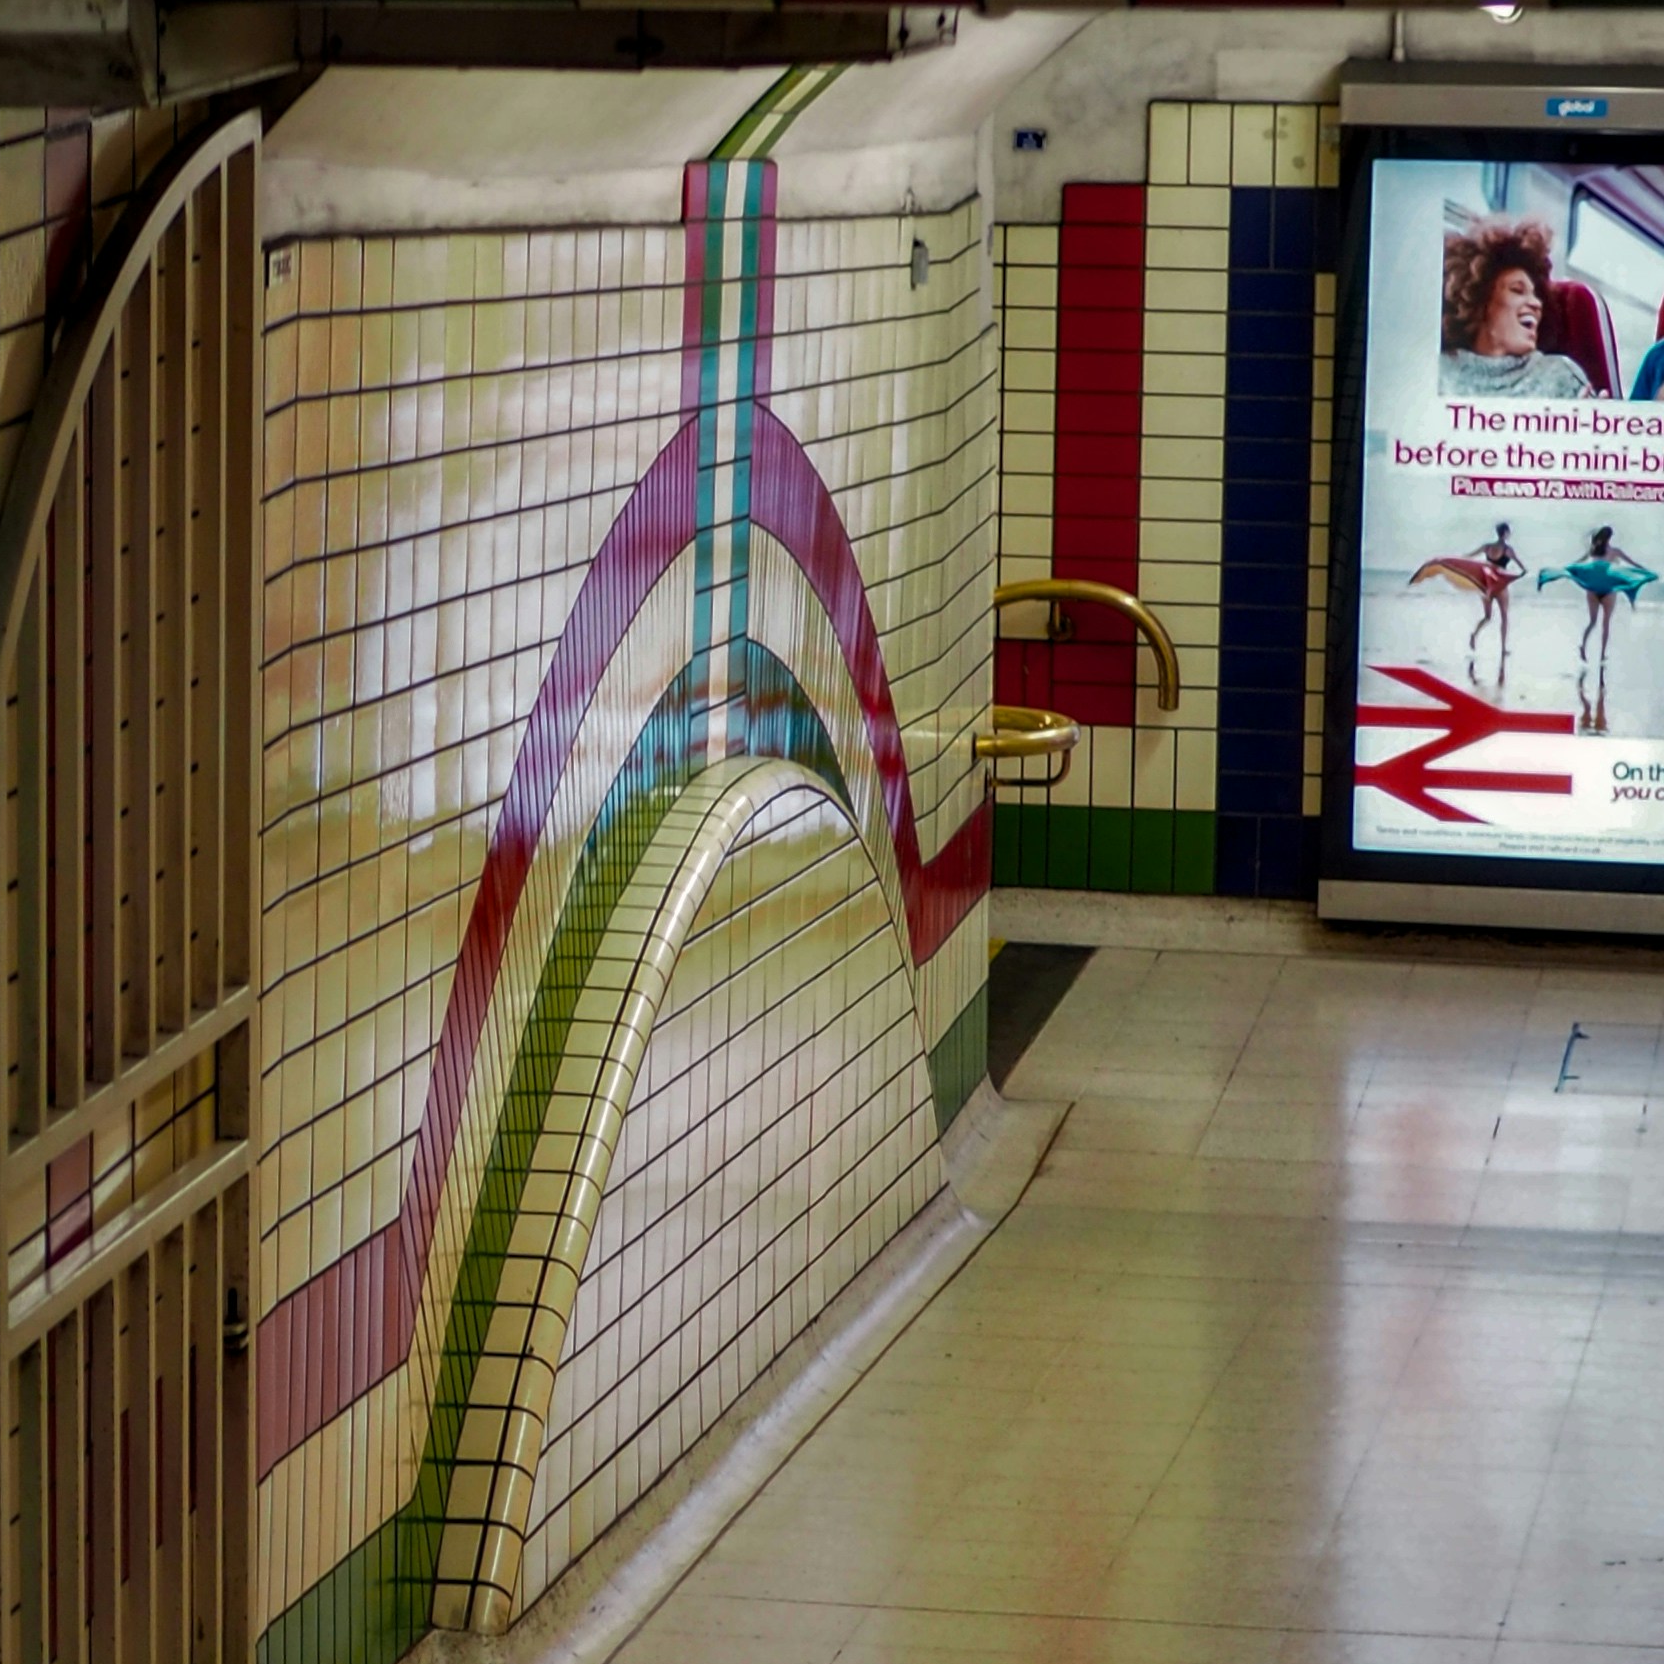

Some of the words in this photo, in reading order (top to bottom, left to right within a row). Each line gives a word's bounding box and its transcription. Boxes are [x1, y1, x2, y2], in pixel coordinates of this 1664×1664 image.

[1446, 404, 1506, 431] The
[1394, 439, 1498, 467] before
[1505, 443, 1556, 469] the
[1562, 445, 1664, 473] mini-b
[1536, 480, 1566, 498] 1/3
[1566, 481, 1602, 499] with
[1612, 761, 1643, 781] On
[1610, 785, 1651, 803] you
